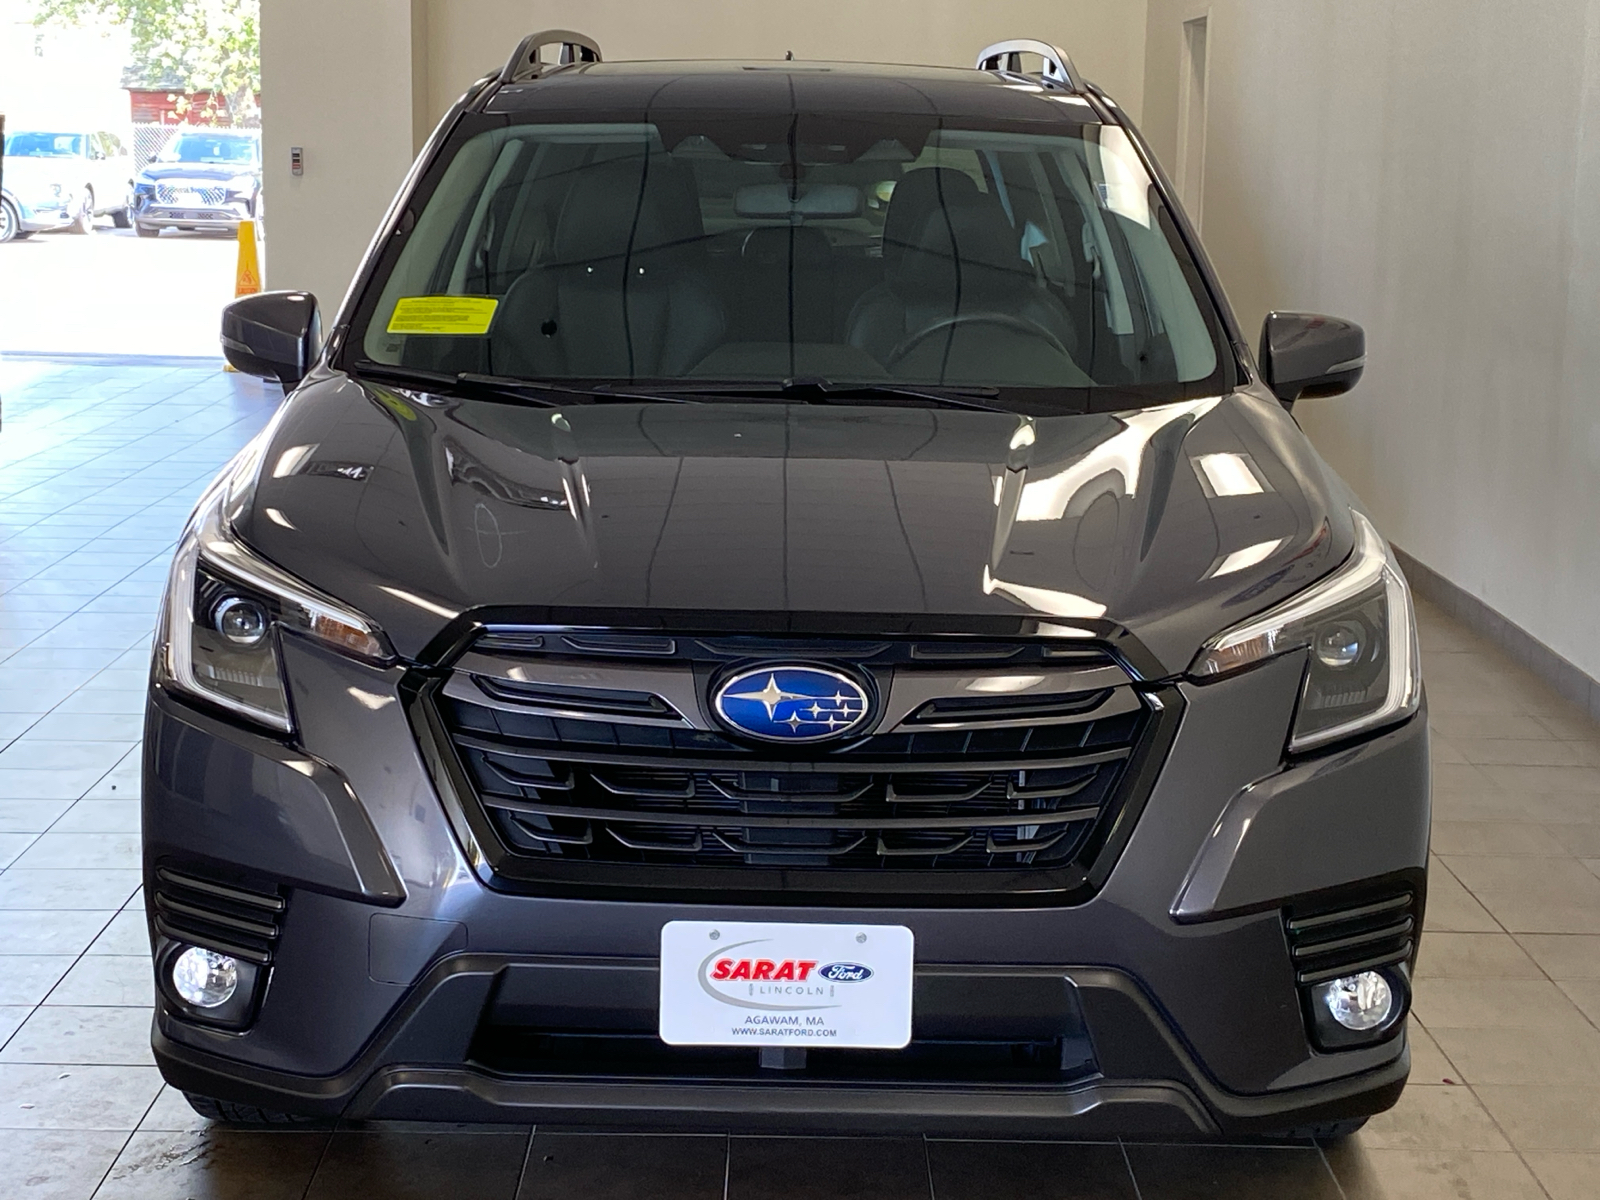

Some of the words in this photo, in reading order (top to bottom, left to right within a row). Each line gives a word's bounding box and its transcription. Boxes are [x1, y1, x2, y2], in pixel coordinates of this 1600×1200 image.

[712, 959, 817, 982] SARAT
[827, 963, 863, 981] Ford
[760, 986, 824, 995] LINCOLN
[744, 1015, 802, 1026] AGAWAM,
[806, 1016, 824, 1026] MA
[731, 1027, 837, 1037] WWW.SARATFORD.COM
